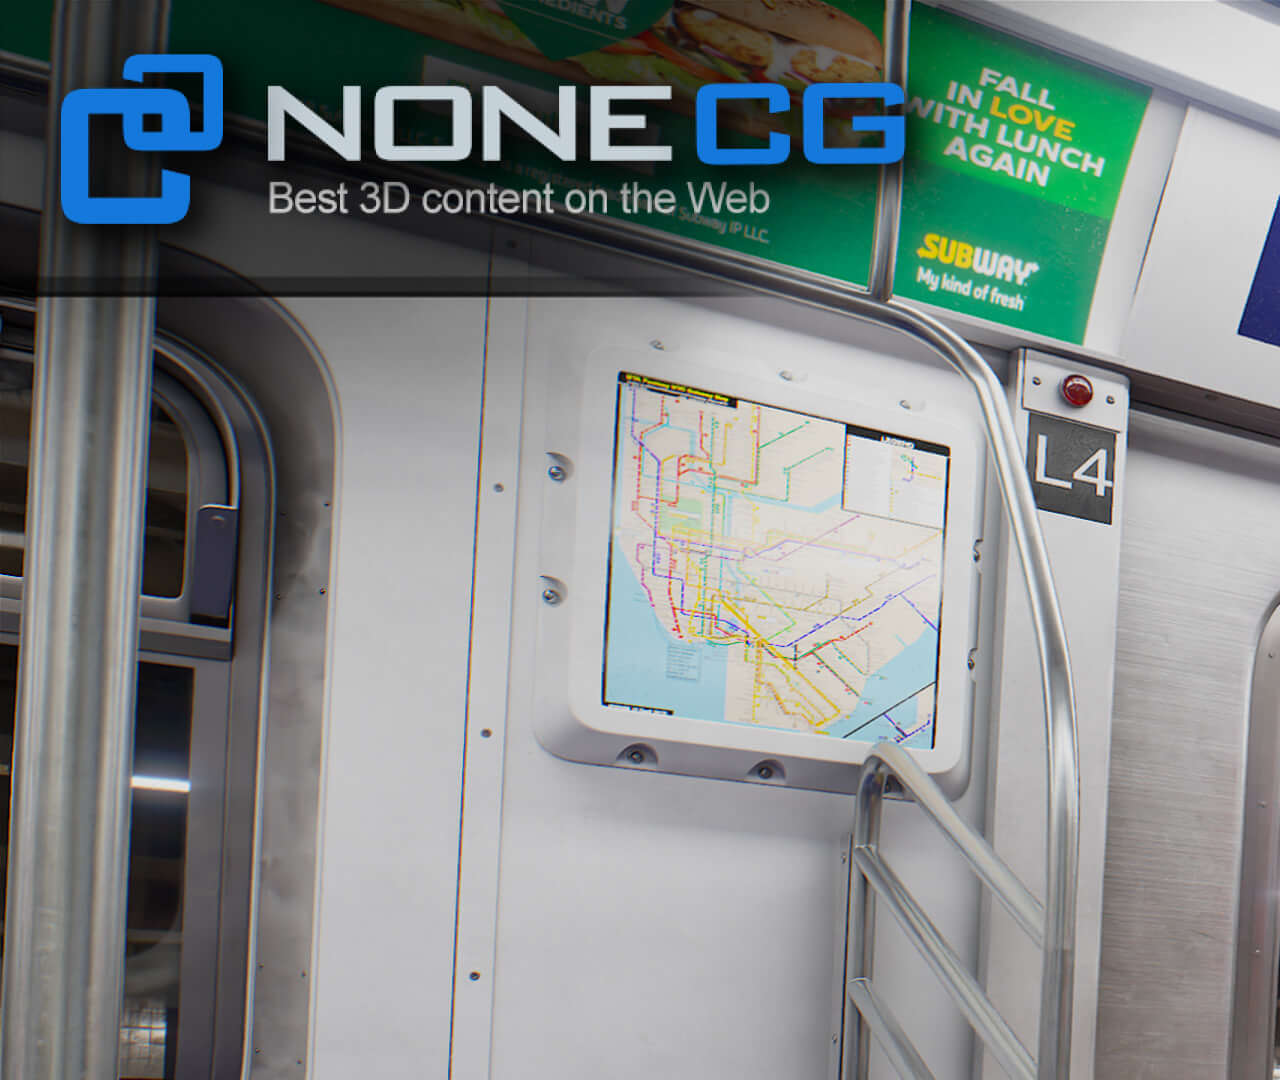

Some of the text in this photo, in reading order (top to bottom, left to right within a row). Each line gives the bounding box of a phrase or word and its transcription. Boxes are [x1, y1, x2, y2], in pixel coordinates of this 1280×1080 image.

[947, 81, 1076, 142] IN LOVE
[979, 67, 1055, 110] FALL
[906, 96, 1106, 177] WITH LUNCH
[943, 136, 1050, 187] AGAIN
[916, 233, 1040, 286] SUBWAY
[917, 265, 1025, 312] My kind of fresh
[1035, 433, 1113, 496] L4
